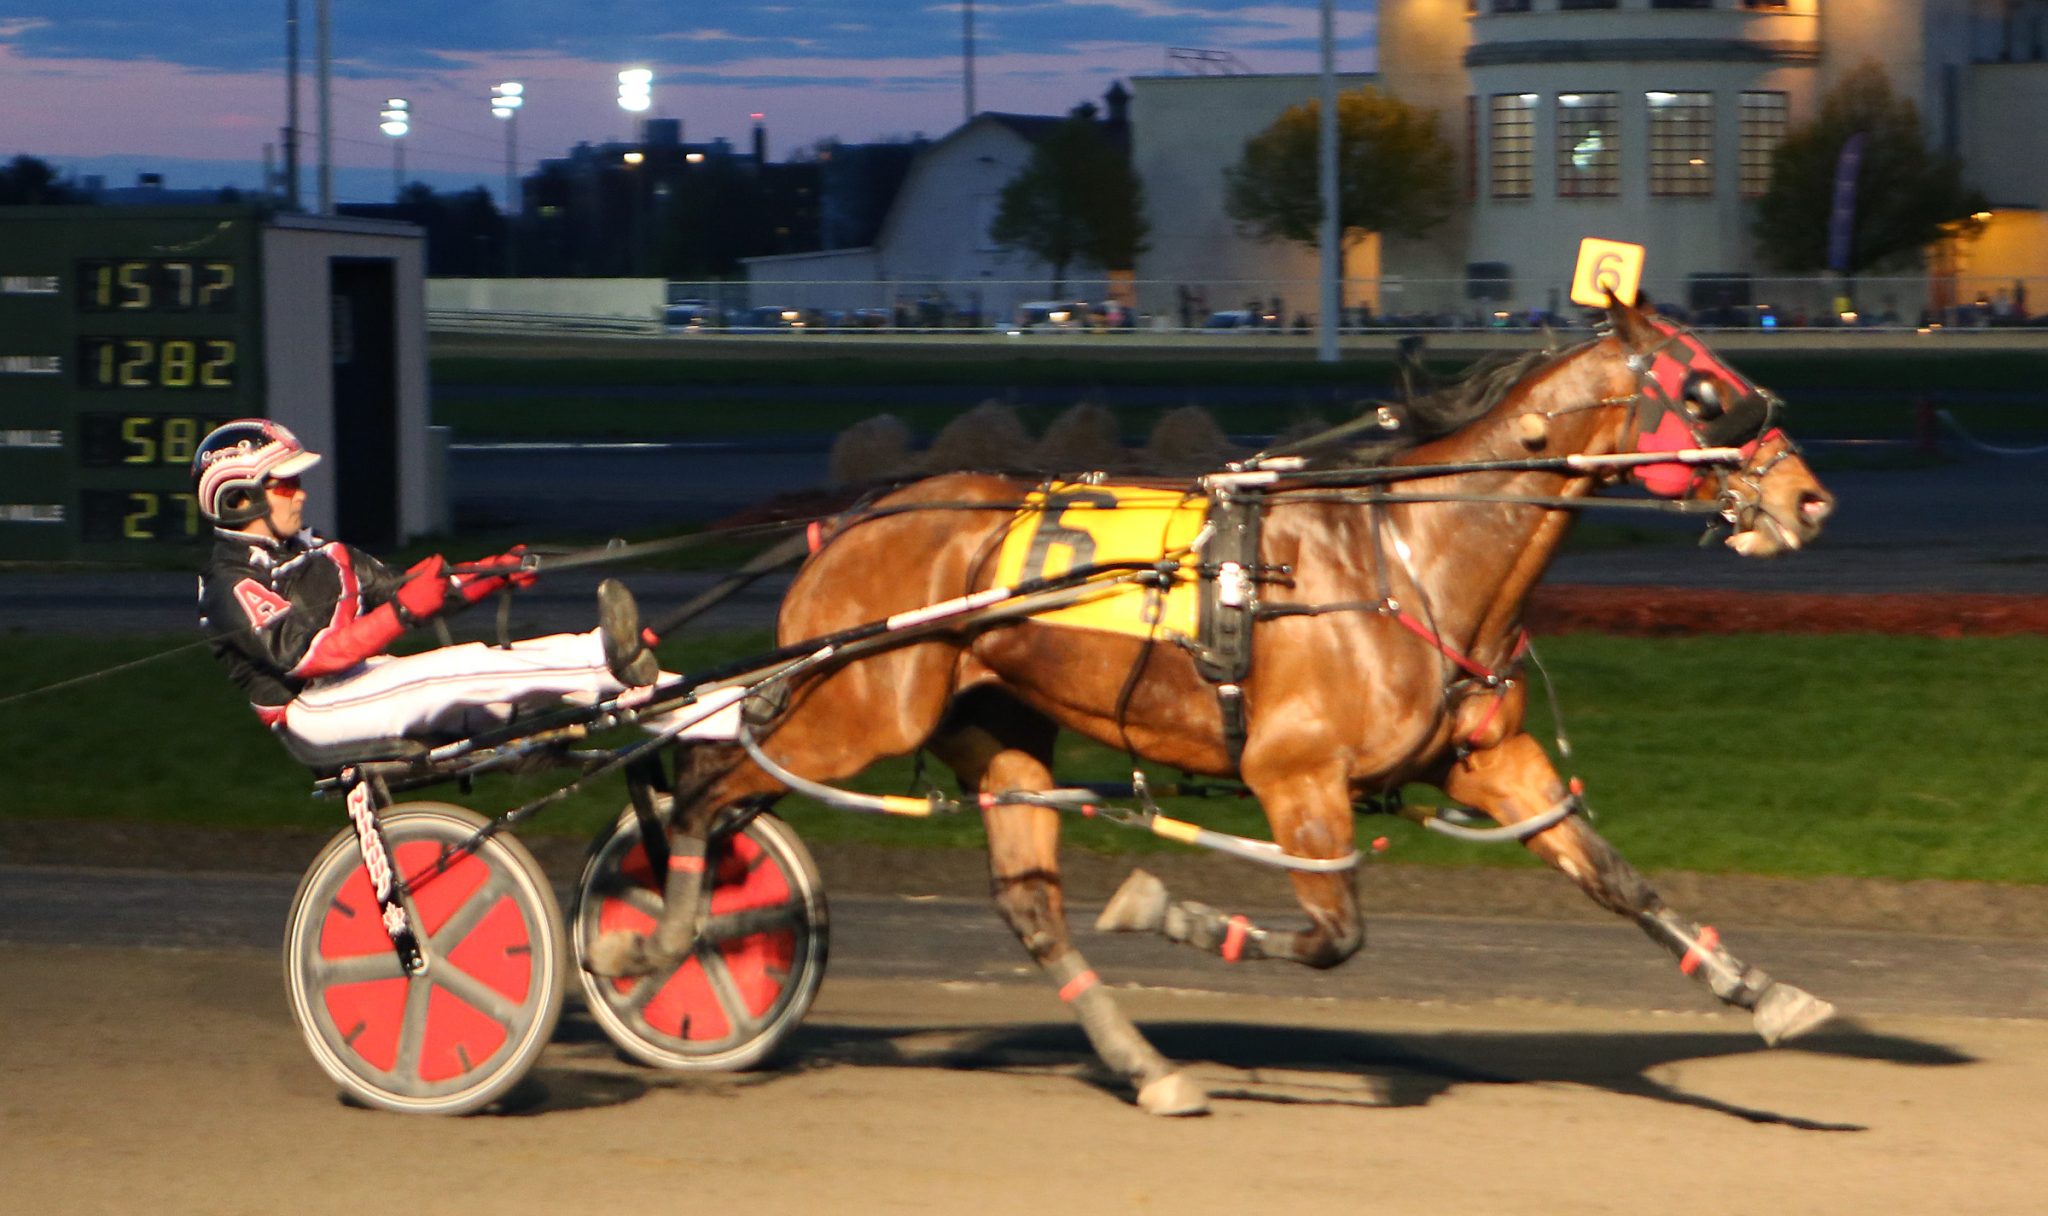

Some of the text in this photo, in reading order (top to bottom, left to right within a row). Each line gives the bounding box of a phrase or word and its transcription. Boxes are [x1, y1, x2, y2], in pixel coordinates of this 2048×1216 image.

[1590, 252, 1624, 295] 6
[99, 339, 236, 388] 1282
[1020, 490, 1117, 586] 6
[234, 577, 292, 634] A
